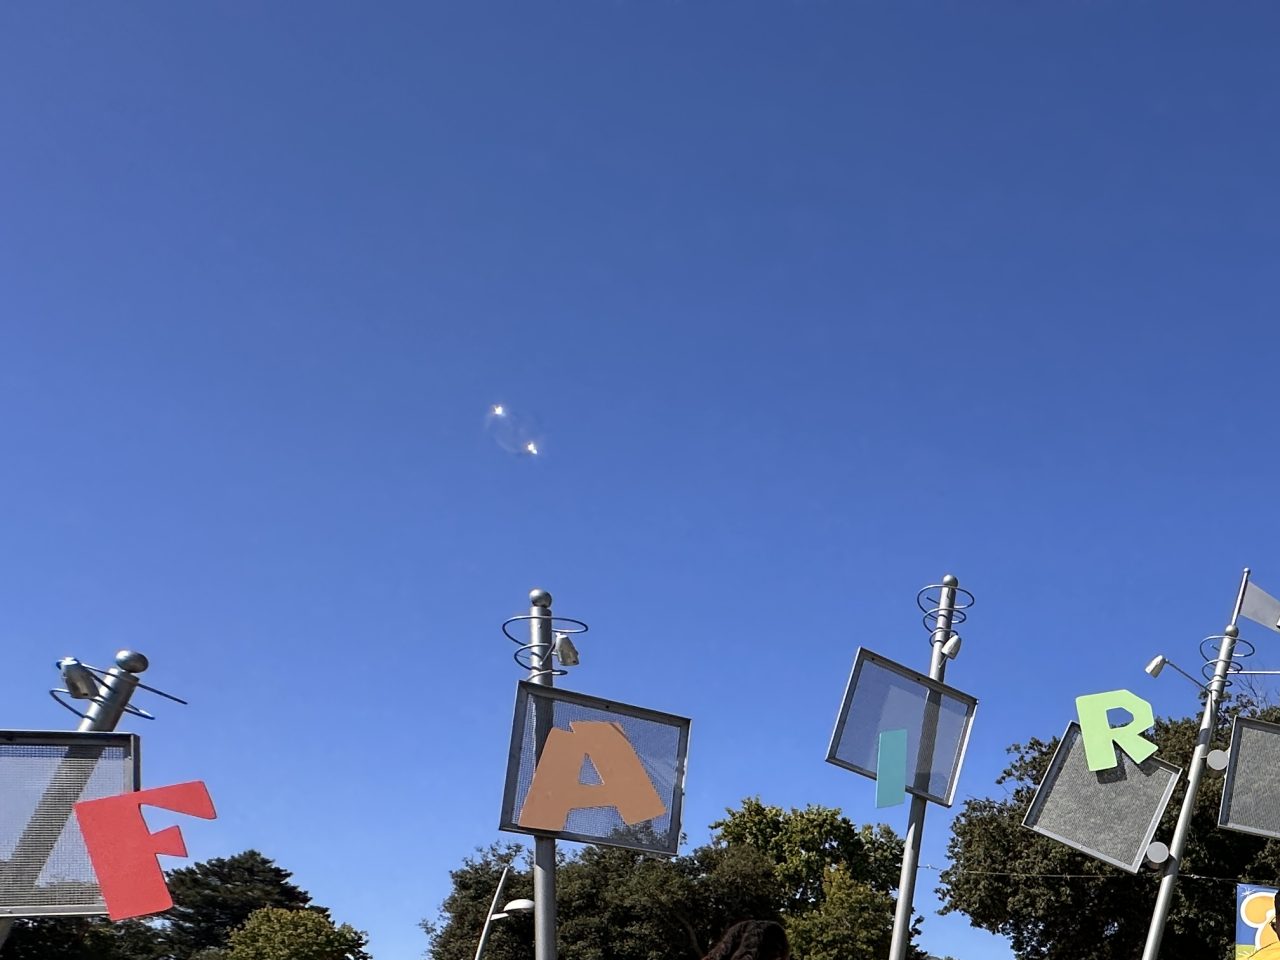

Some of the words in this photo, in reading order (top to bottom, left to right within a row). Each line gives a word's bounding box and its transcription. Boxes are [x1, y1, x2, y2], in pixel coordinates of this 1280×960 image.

[75, 781, 216, 920] F
[519, 721, 666, 832] A
[876, 730, 907, 808] I
[1075, 689, 1158, 772] R
